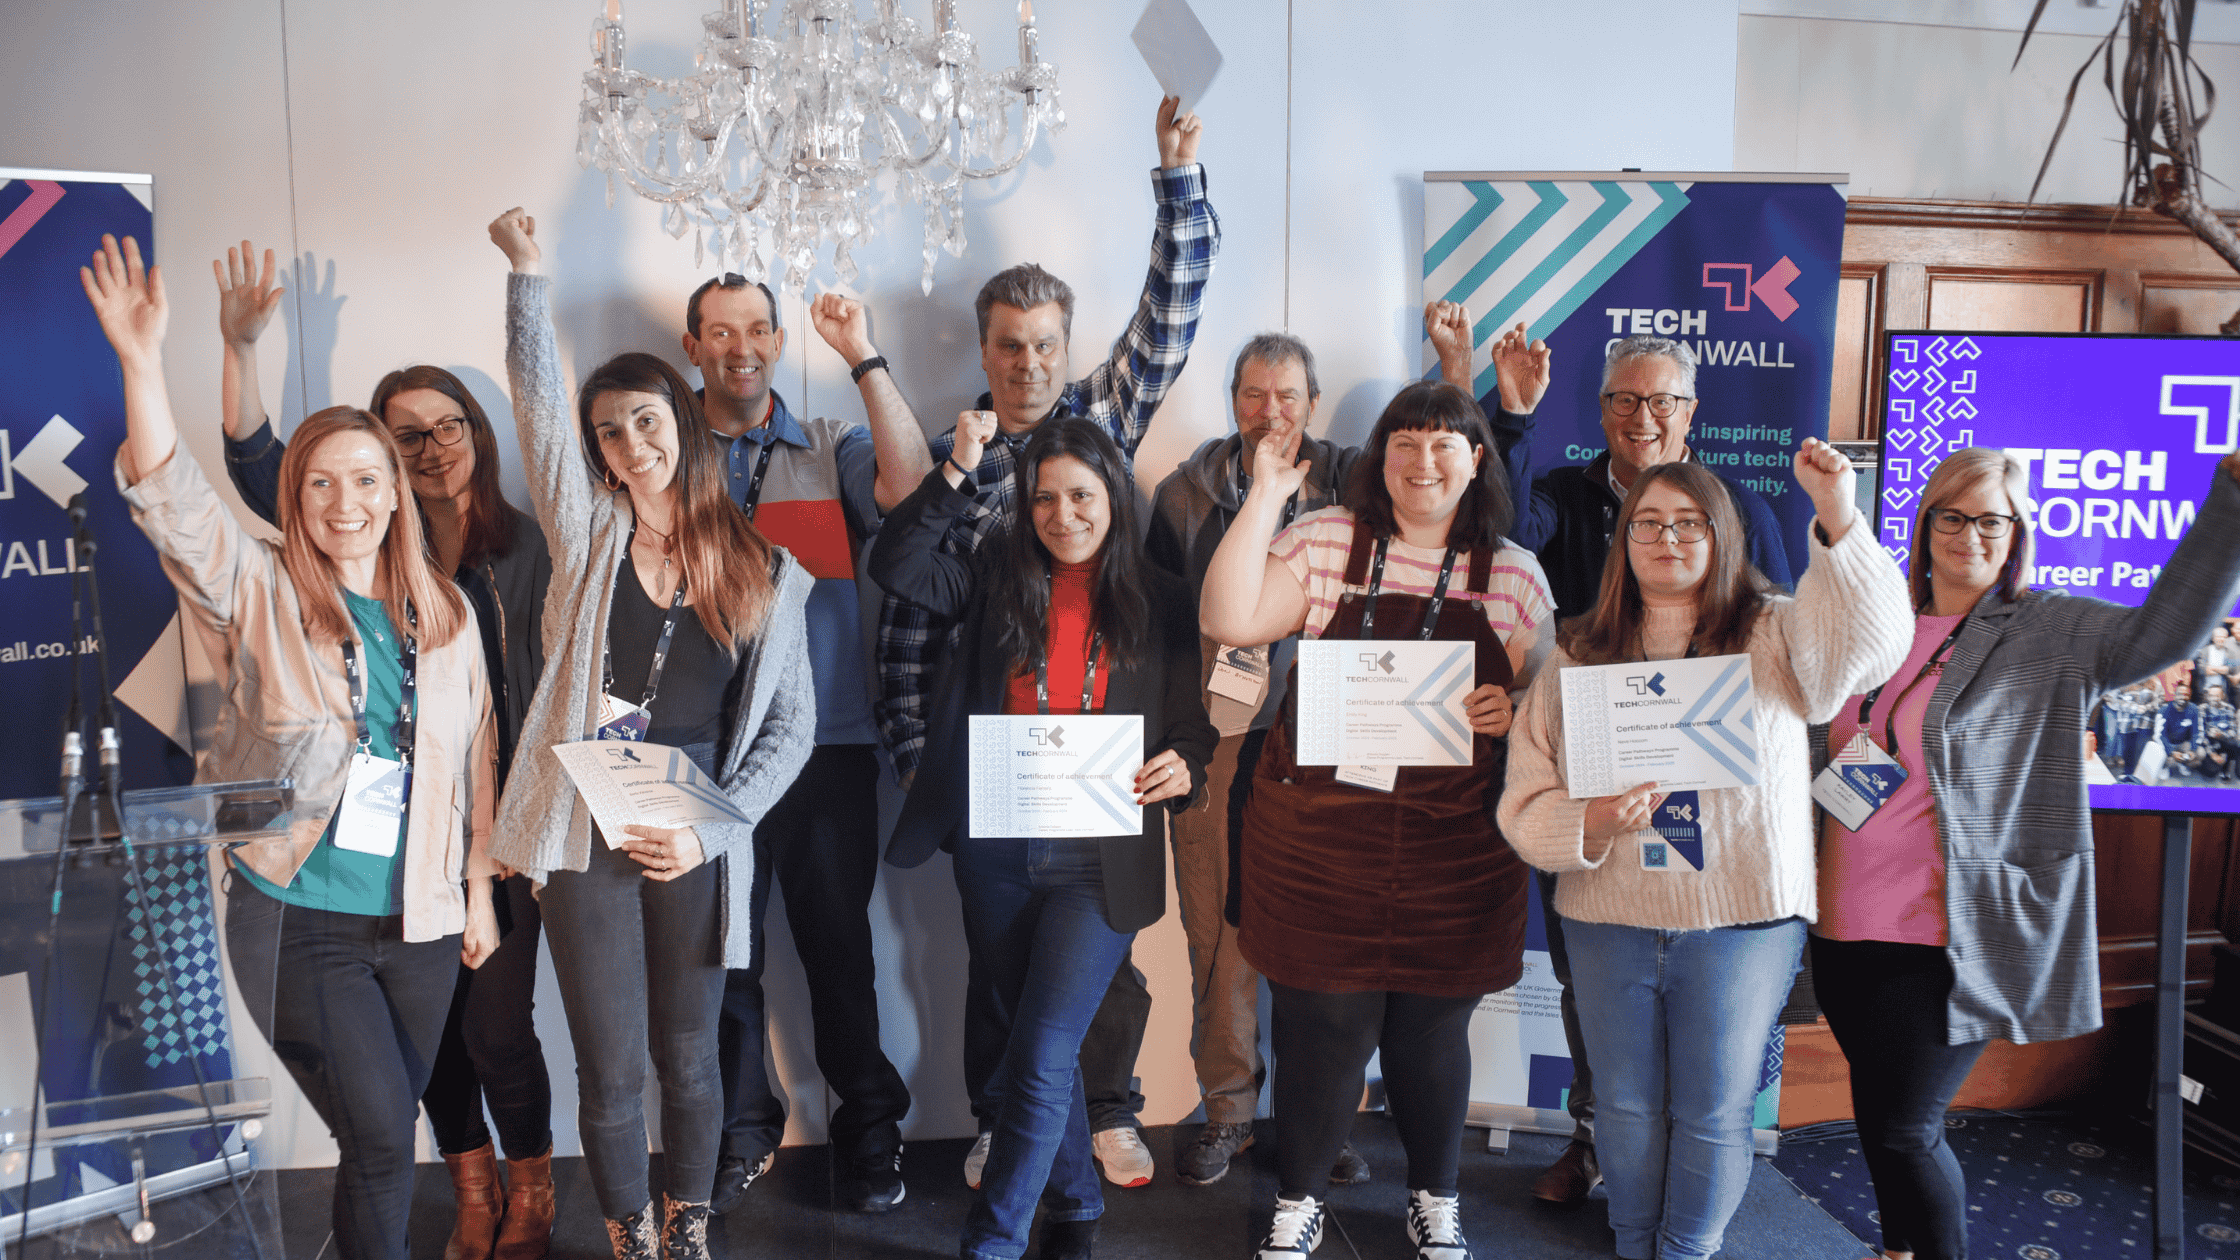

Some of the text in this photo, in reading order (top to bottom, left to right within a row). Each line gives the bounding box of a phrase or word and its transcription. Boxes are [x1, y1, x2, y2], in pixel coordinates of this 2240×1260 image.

[1605, 308, 1707, 335] TECH
[1605, 338, 1795, 368] CNWALL
[1701, 423, 1793, 446] inspiring
[1565, 444, 1608, 461] Cor
[1744, 451, 1790, 468] tech
[2003, 448, 2168, 491] TECH
[1740, 477, 1788, 496] nity.
[2026, 497, 2196, 540] ORNW
[0, 538, 90, 578] ALL
[2111, 562, 2162, 588] Pat
[0, 635, 100, 663] all.co.uk
[1237, 650, 1253, 660] TECH
[1345, 698, 1385, 706] Certificate
[1395, 699, 1444, 707] achievement
[605, 727, 622, 738] TECH
[1616, 719, 1722, 733] Certificate of achievement
[1533, 986, 1563, 994] Governm
[1489, 999, 1522, 1008] monitoring
[1493, 1007, 1520, 1015] Cornwall
